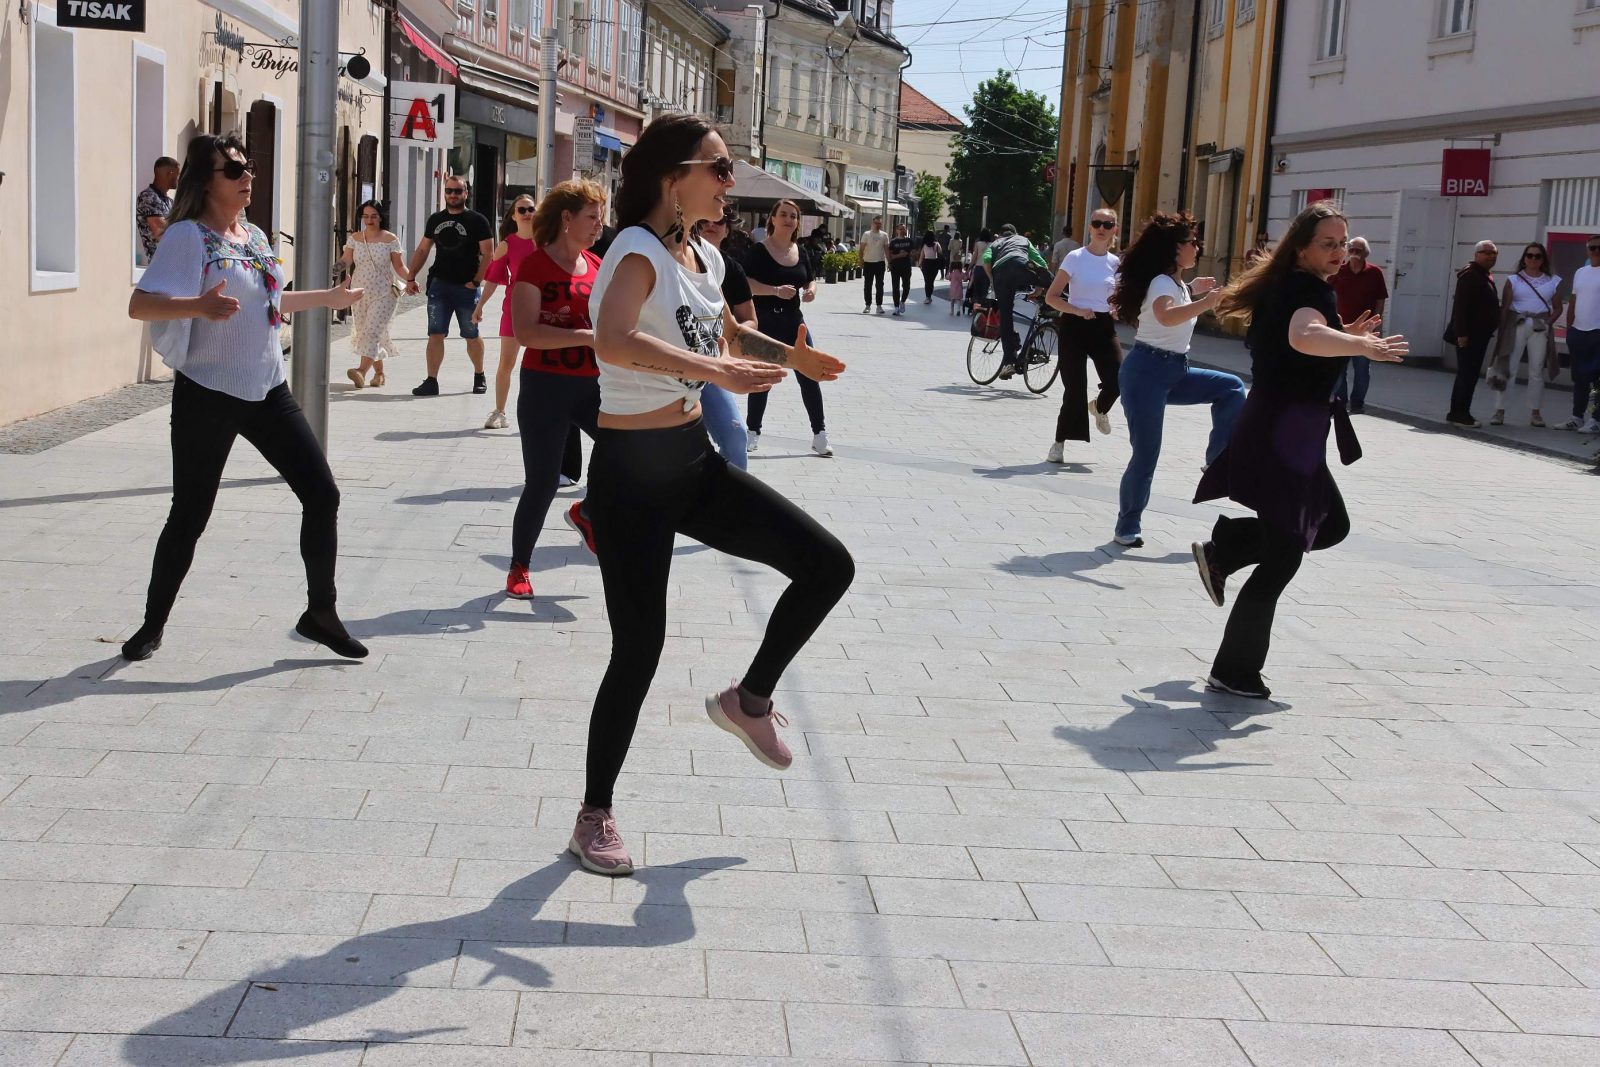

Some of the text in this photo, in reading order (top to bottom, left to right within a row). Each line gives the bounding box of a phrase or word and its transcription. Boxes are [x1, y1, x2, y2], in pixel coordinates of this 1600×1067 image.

[67, 0, 132, 20] TISAK
[400, 93, 445, 139] A1
[1446, 179, 1486, 193] BIPA
